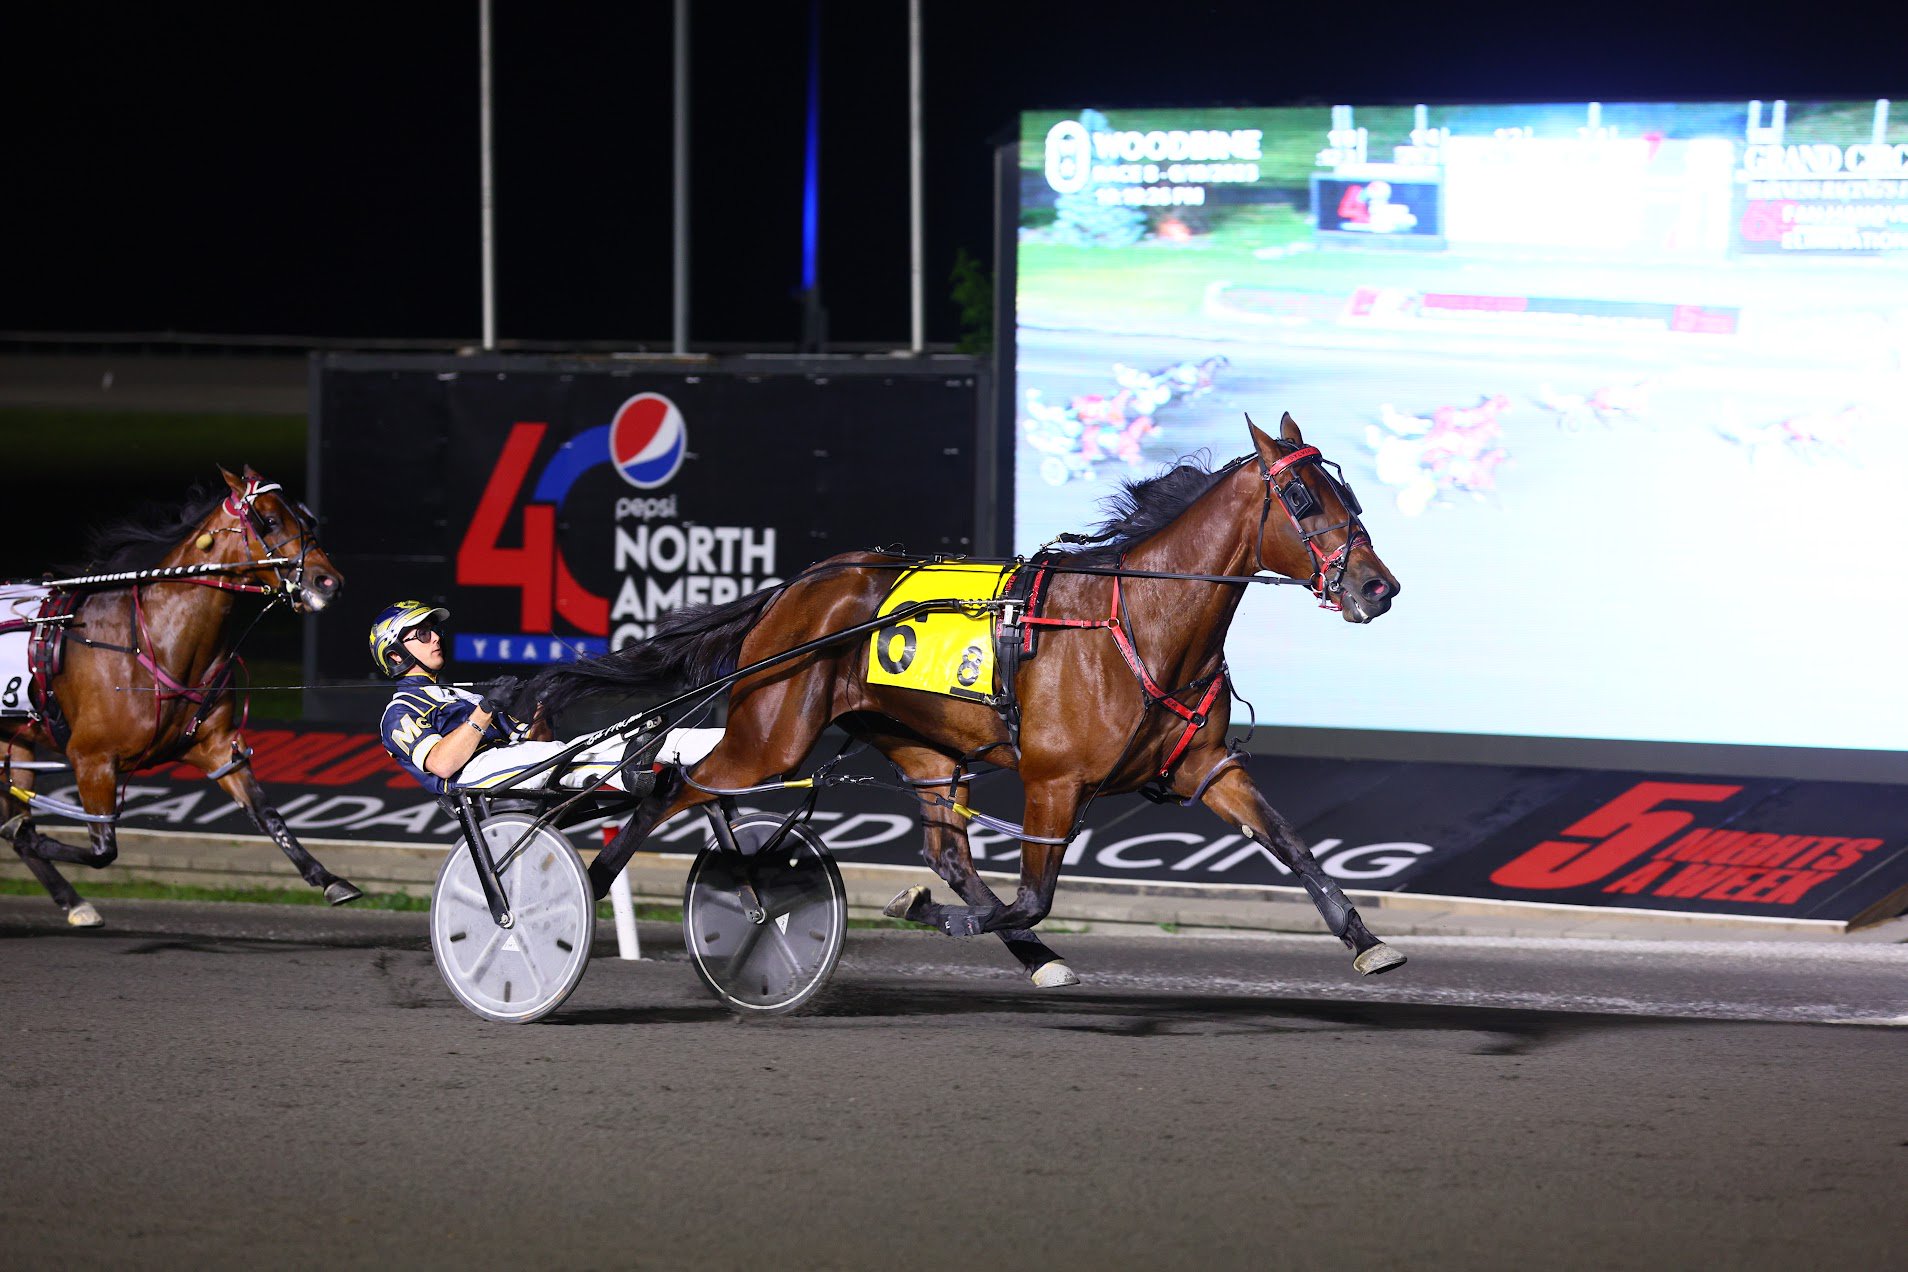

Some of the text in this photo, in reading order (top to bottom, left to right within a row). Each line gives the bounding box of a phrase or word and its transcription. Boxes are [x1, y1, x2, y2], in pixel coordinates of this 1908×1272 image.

[615, 494, 679, 522] pepsi
[614, 524, 776, 575] NORTH
[610, 574, 788, 623] AMER
[472, 639, 589, 660] YEARS
[957, 645, 984, 687] 8
[2, 676, 22, 708] 8
[391, 714, 432, 757] Mc
[1490, 781, 1743, 889] 5
[1651, 827, 1885, 871] NIGHTS
[1601, 860, 1838, 905] A WEEK
